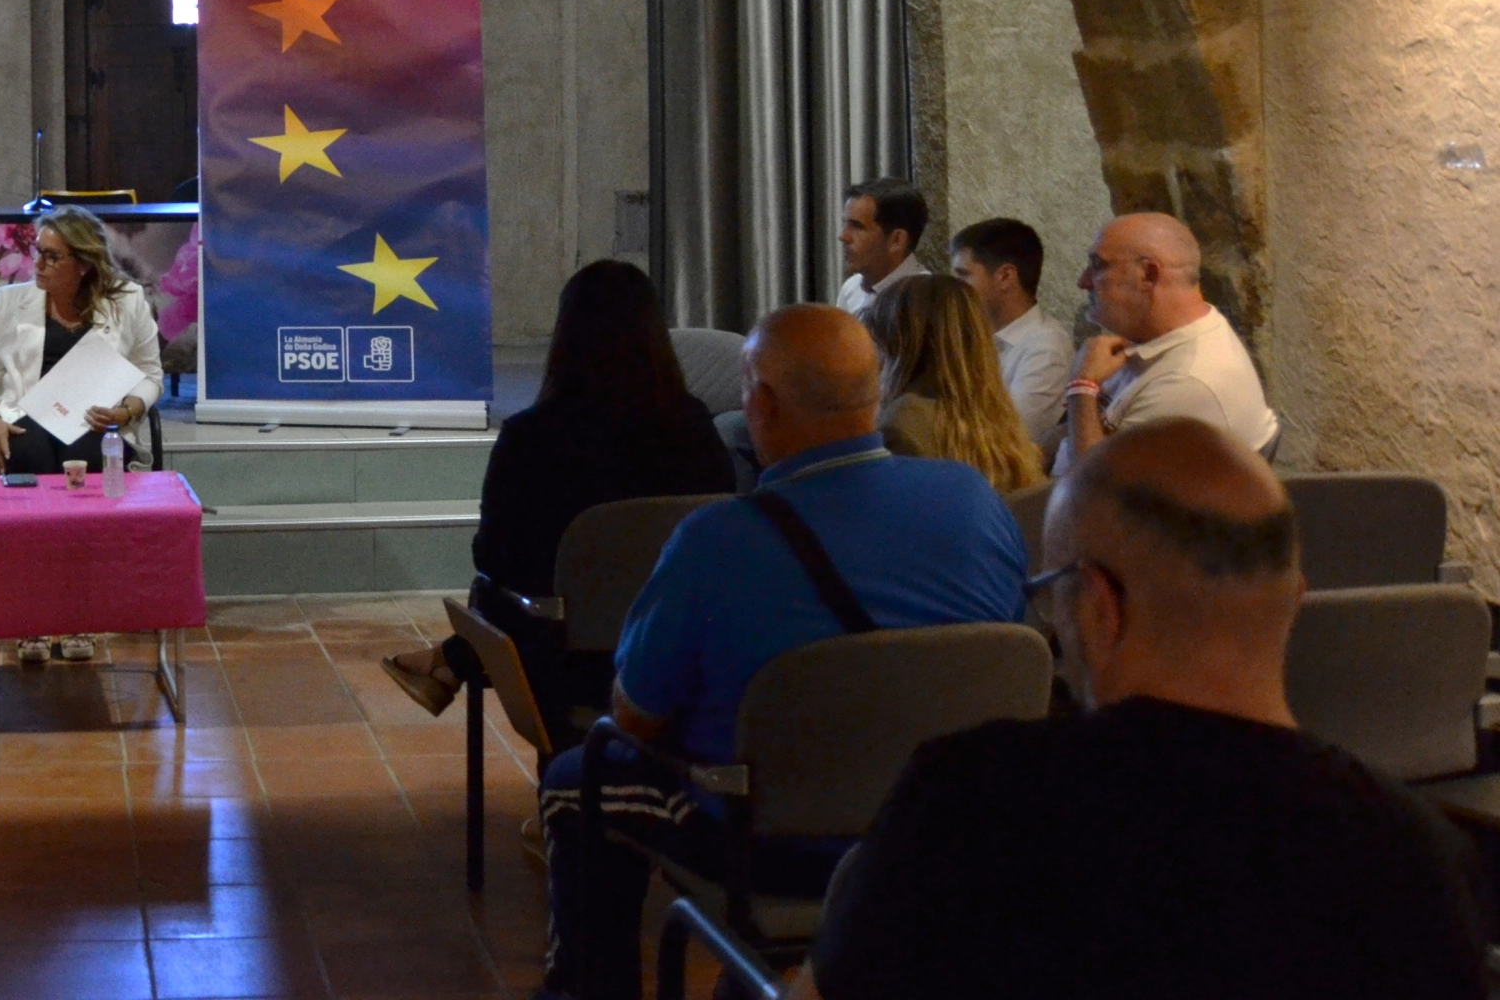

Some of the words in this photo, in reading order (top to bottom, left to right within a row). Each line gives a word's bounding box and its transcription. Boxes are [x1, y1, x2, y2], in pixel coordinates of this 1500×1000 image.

[284, 335, 293, 343] La
[294, 335, 322, 343] Almunia
[294, 343, 312, 351] Doña
[312, 343, 337, 351] Godina
[284, 352, 339, 370] PSOE
